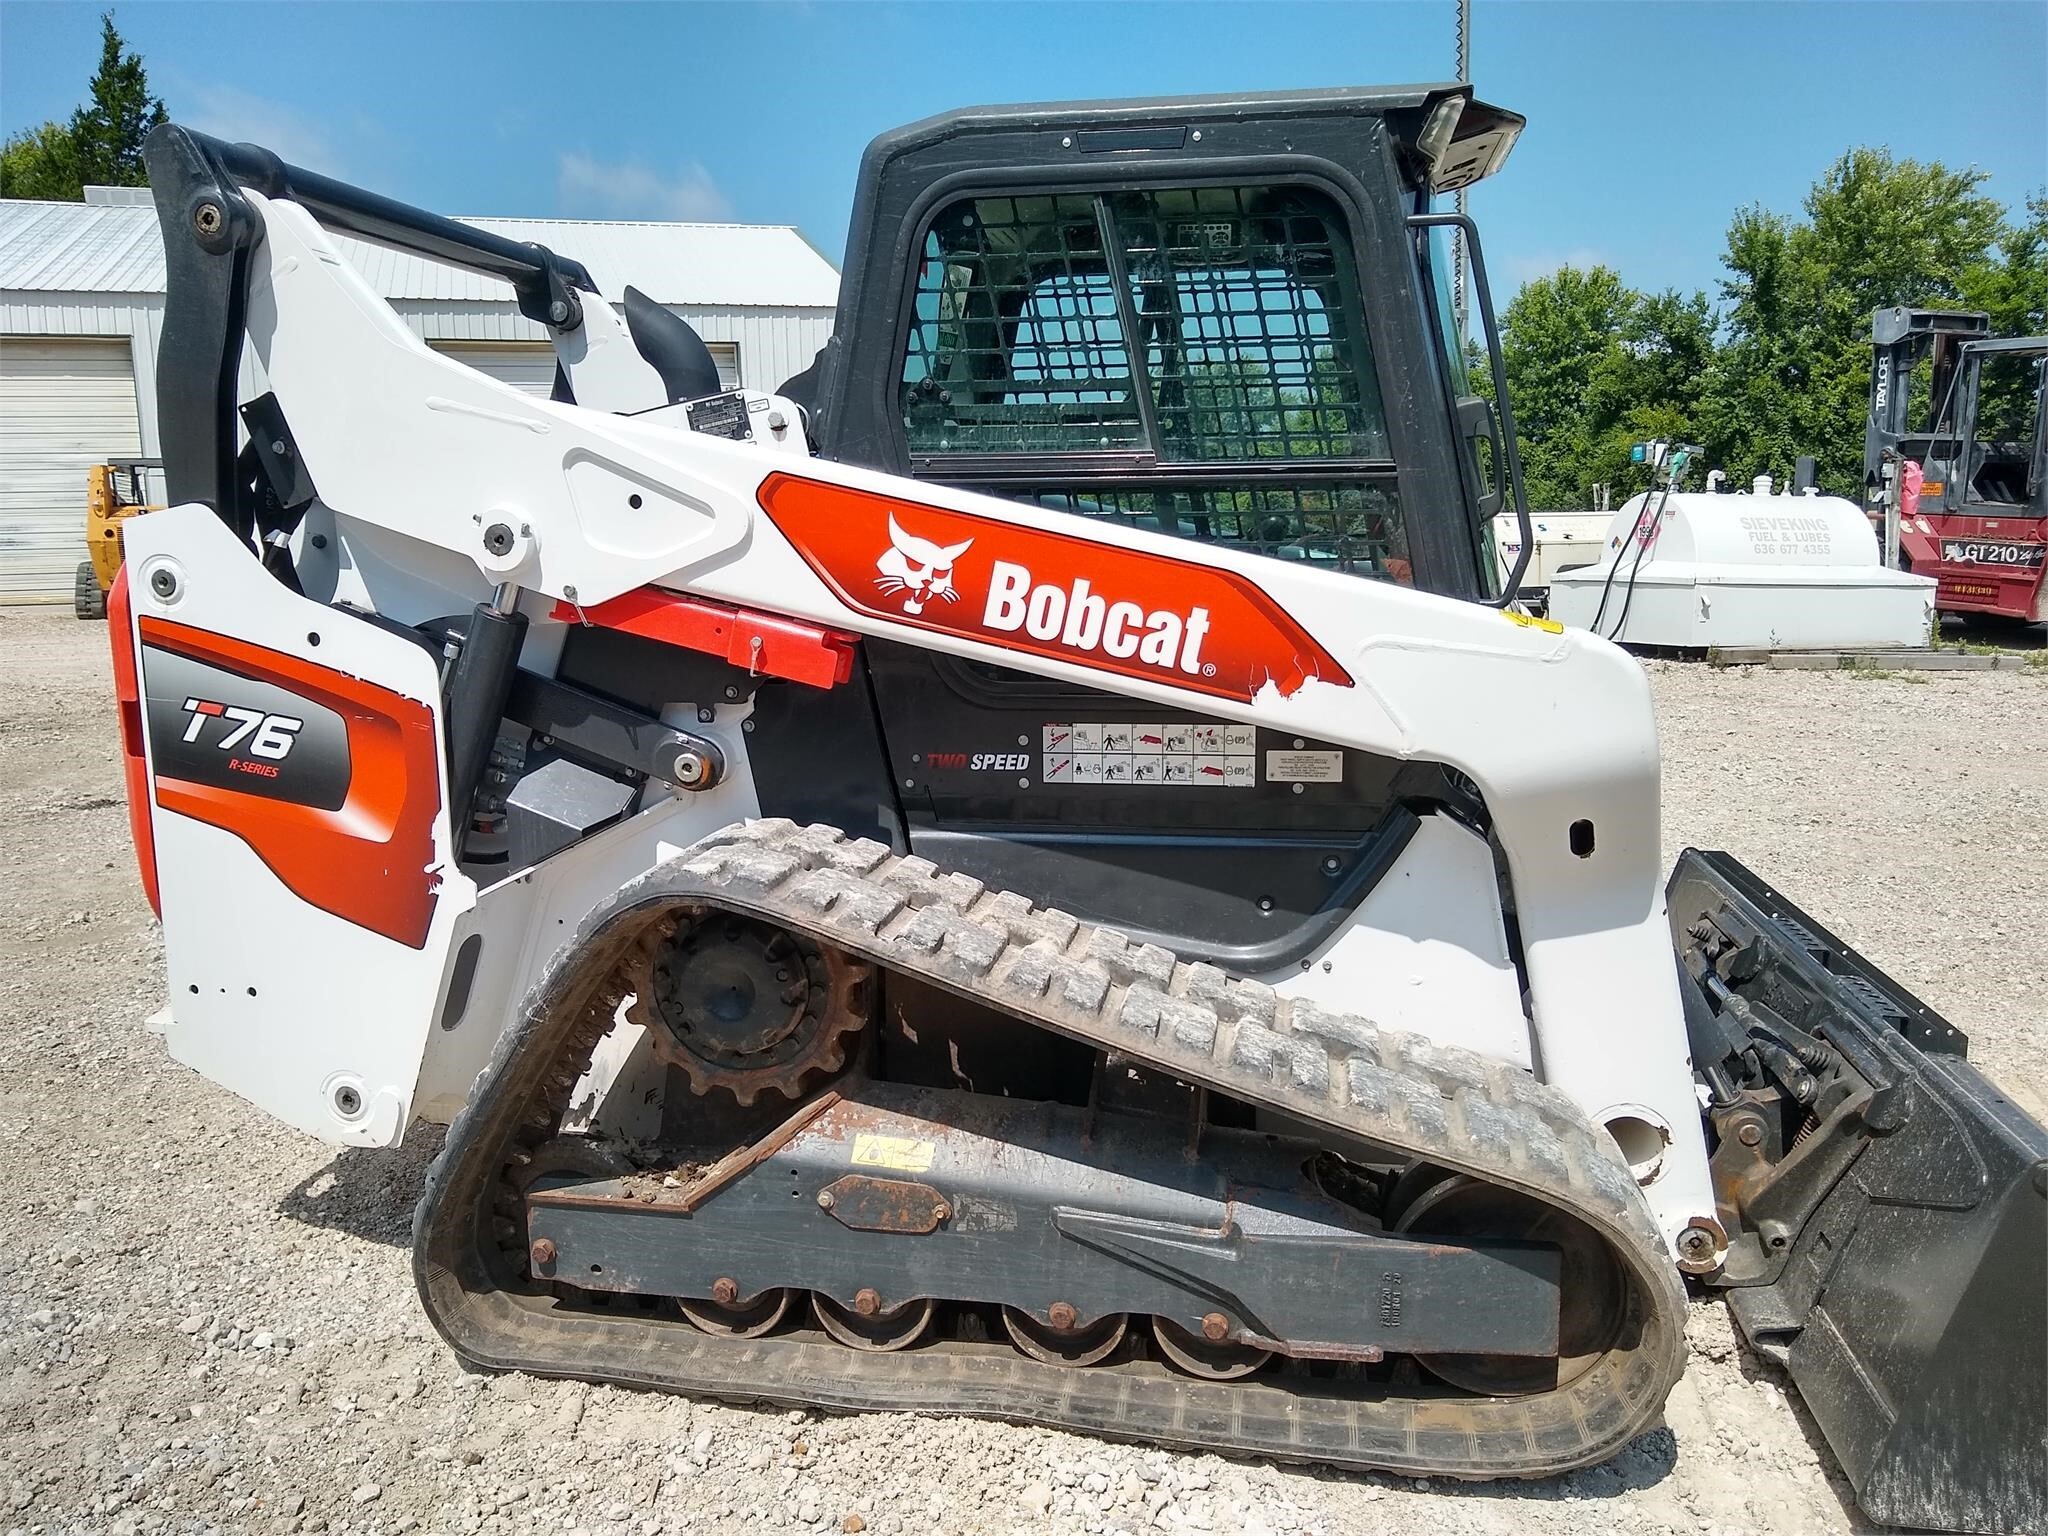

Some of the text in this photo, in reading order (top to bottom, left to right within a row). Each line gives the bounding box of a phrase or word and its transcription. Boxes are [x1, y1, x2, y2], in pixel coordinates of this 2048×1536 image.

[1876, 356, 1889, 411] TAYLOR
[1740, 517, 1830, 531] SIEVEKING
[1748, 532, 1832, 543] FUEL & LUBES
[1754, 543, 1832, 555] 636 677 4355
[982, 560, 1210, 674] Bobcat
[181, 696, 303, 760] T76
[229, 759, 279, 778] R-SERIES
[927, 753, 1030, 770] TWO SPEED
